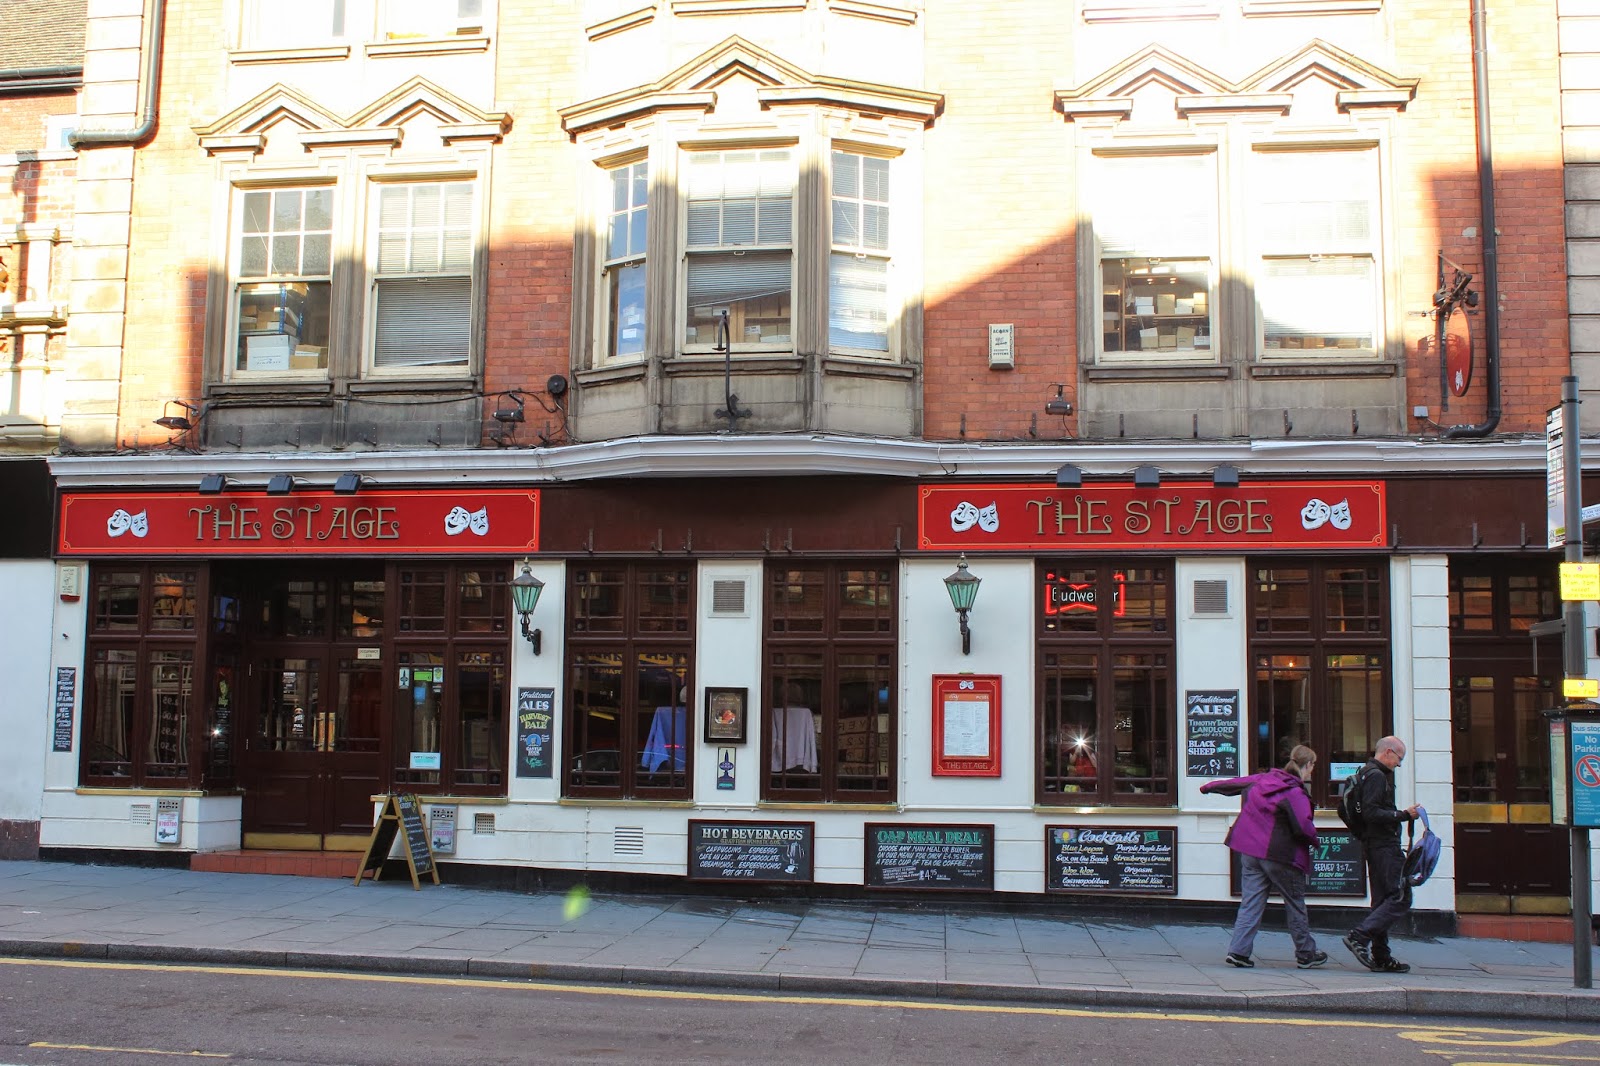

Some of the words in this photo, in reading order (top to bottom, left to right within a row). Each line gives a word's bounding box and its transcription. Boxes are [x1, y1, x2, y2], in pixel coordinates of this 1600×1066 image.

[1026, 494, 1113, 535] THE
[1124, 496, 1273, 535] STAGE
[188, 503, 262, 540] THE
[271, 504, 400, 540] STAGE
[1052, 588, 1118, 602] Budweir
[520, 691, 553, 700] Traditional
[1188, 695, 1236, 704] Traditional
[520, 700, 549, 711] ALES
[1188, 704, 1232, 716] ALES
[520, 712, 551, 722] HARVEST
[525, 721, 547, 729] PALE
[1573, 724, 1585, 732] bus
[1575, 744, 1600, 752] Parkin
[702, 828, 729, 839] HOT
[732, 828, 803, 840] BEVERAGES
[877, 830, 906, 843] OAP
[906, 831, 943, 843] MEAL
[945, 831, 982, 844] DEAL
[1078, 830, 1140, 845] Cocktails
[1116, 844, 1138, 852] Purple
[1113, 854, 1148, 863] Strawberry
[1062, 866, 1078, 874] Woo
[1079, 866, 1094, 874] Woo
[1124, 866, 1153, 874] Orgasm
[1062, 877, 1109, 886] Cosmopolitan
